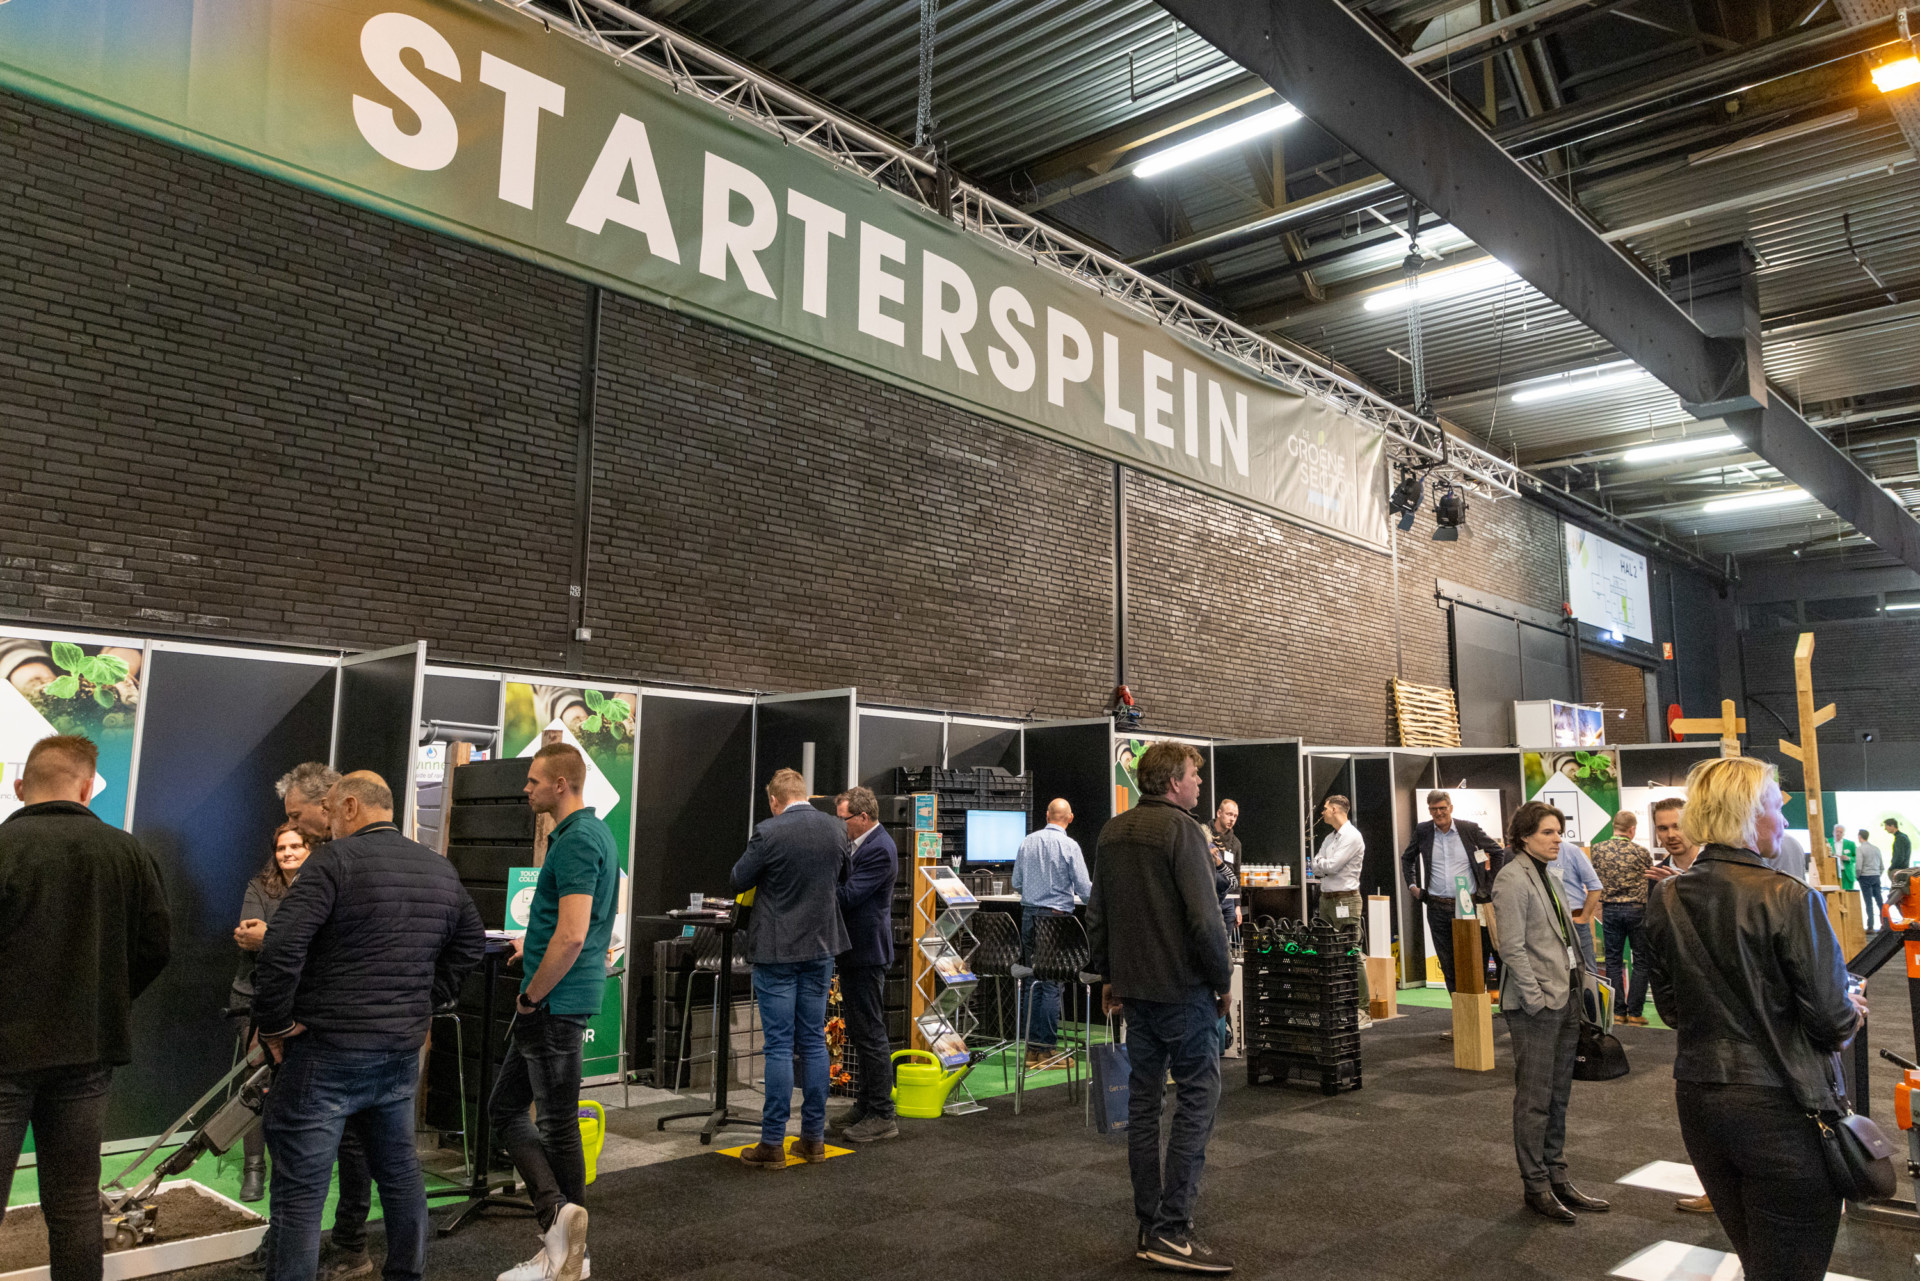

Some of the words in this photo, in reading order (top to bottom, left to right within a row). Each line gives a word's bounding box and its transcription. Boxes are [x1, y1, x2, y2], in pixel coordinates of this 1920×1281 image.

[352, 12, 1249, 477] STARTERSPLEIN
[1287, 434, 1346, 479] GROENE
[1620, 560, 1633, 576] HAL
[1633, 564, 1638, 578] 2
